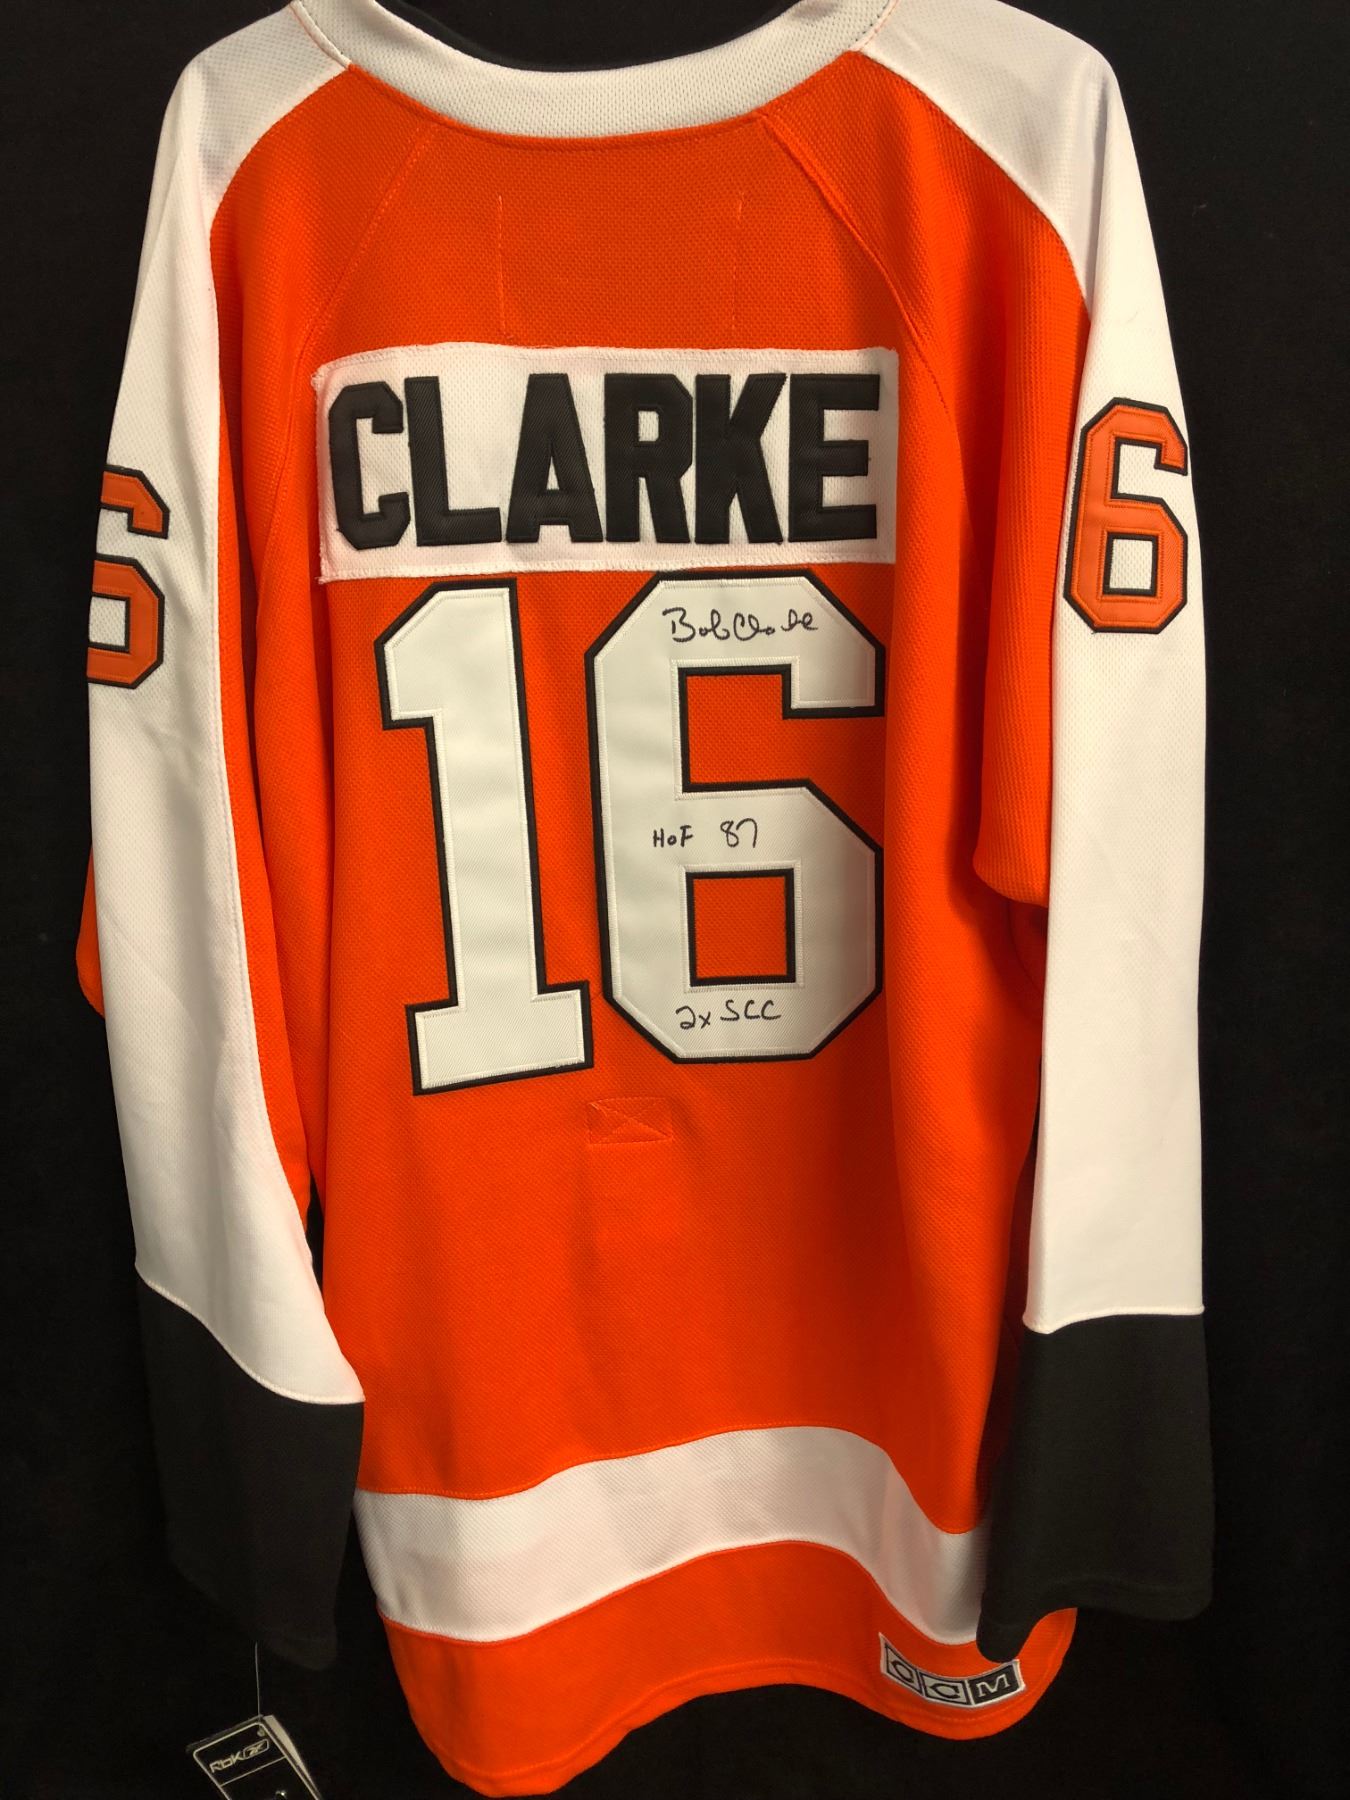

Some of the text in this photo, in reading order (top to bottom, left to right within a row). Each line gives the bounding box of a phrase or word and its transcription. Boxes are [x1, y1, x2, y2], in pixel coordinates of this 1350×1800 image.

[328, 373, 880, 550] CLARKE
[1063, 396, 1189, 634] 6
[662, 606, 731, 643] Bob
[374, 568, 886, 1097] 16
[719, 817, 758, 849] 87
[719, 999, 782, 1021] SCC
[890, 1659, 1011, 1700] CCM
